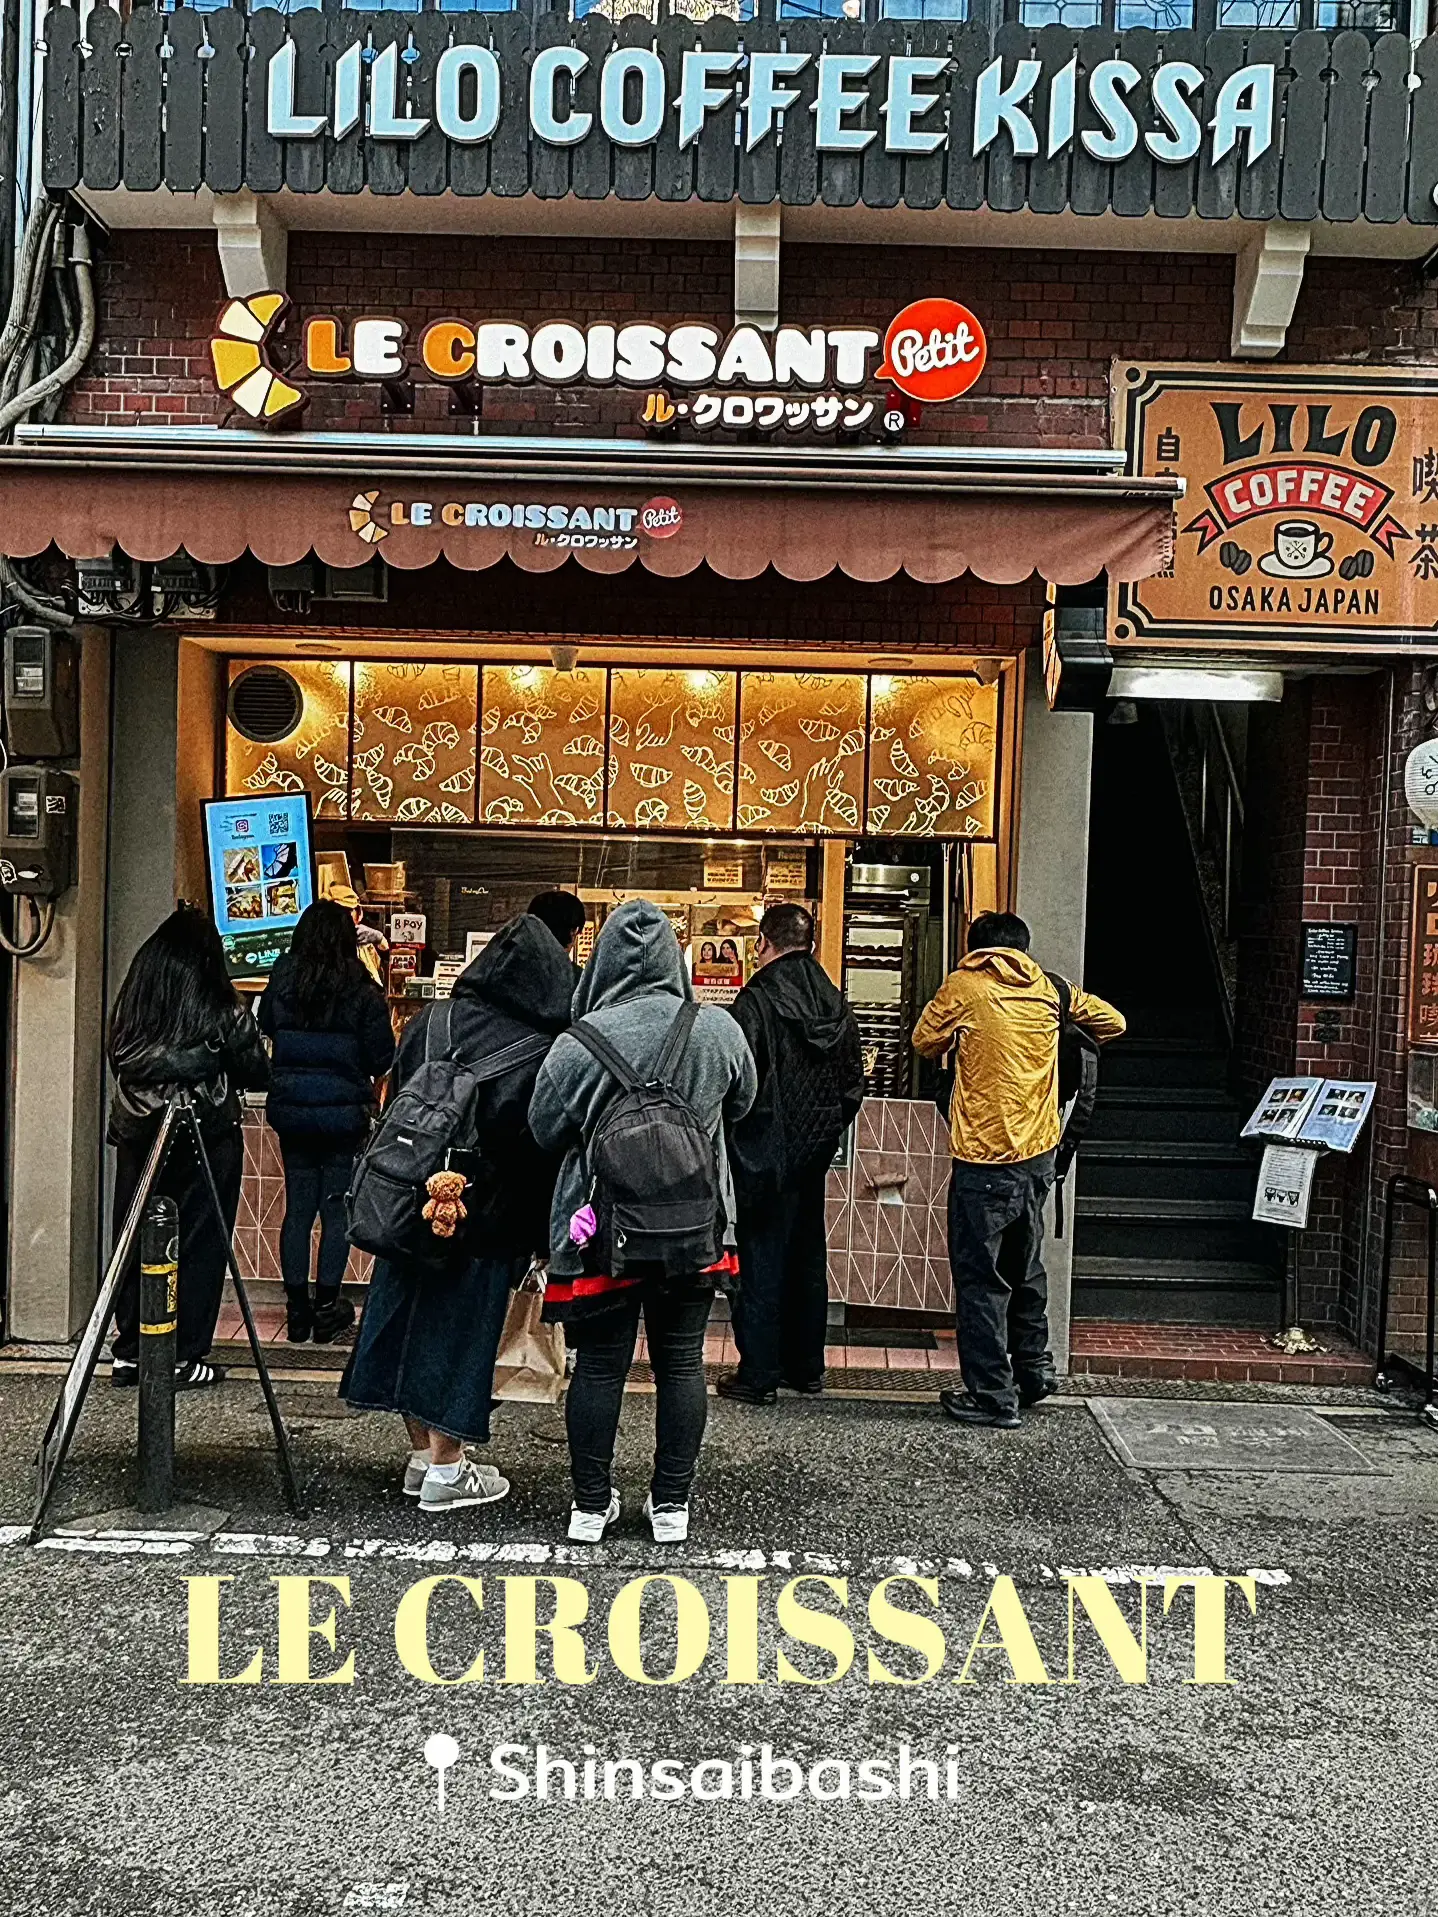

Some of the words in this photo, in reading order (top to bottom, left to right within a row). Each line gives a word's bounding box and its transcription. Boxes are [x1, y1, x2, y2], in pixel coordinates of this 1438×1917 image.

[266, 34, 502, 143] LILO
[529, 42, 951, 153] COFFEE
[972, 53, 1275, 167] KISSA
[306, 319, 402, 374] LE
[421, 322, 879, 384] CROISSANT
[891, 325, 981, 377] Petit
[641, 392, 874, 427] ル・クロワッサン
[1209, 401, 1397, 467] LILO
[1223, 468, 1375, 519] COFFEE
[390, 502, 433, 526] LE
[441, 503, 638, 532] CROISSANT
[642, 507, 681, 529] Petit
[534, 532, 638, 549] ル・クロワッサン
[1209, 585, 1292, 613] OSAKA
[1297, 587, 1380, 615] JAPAN
